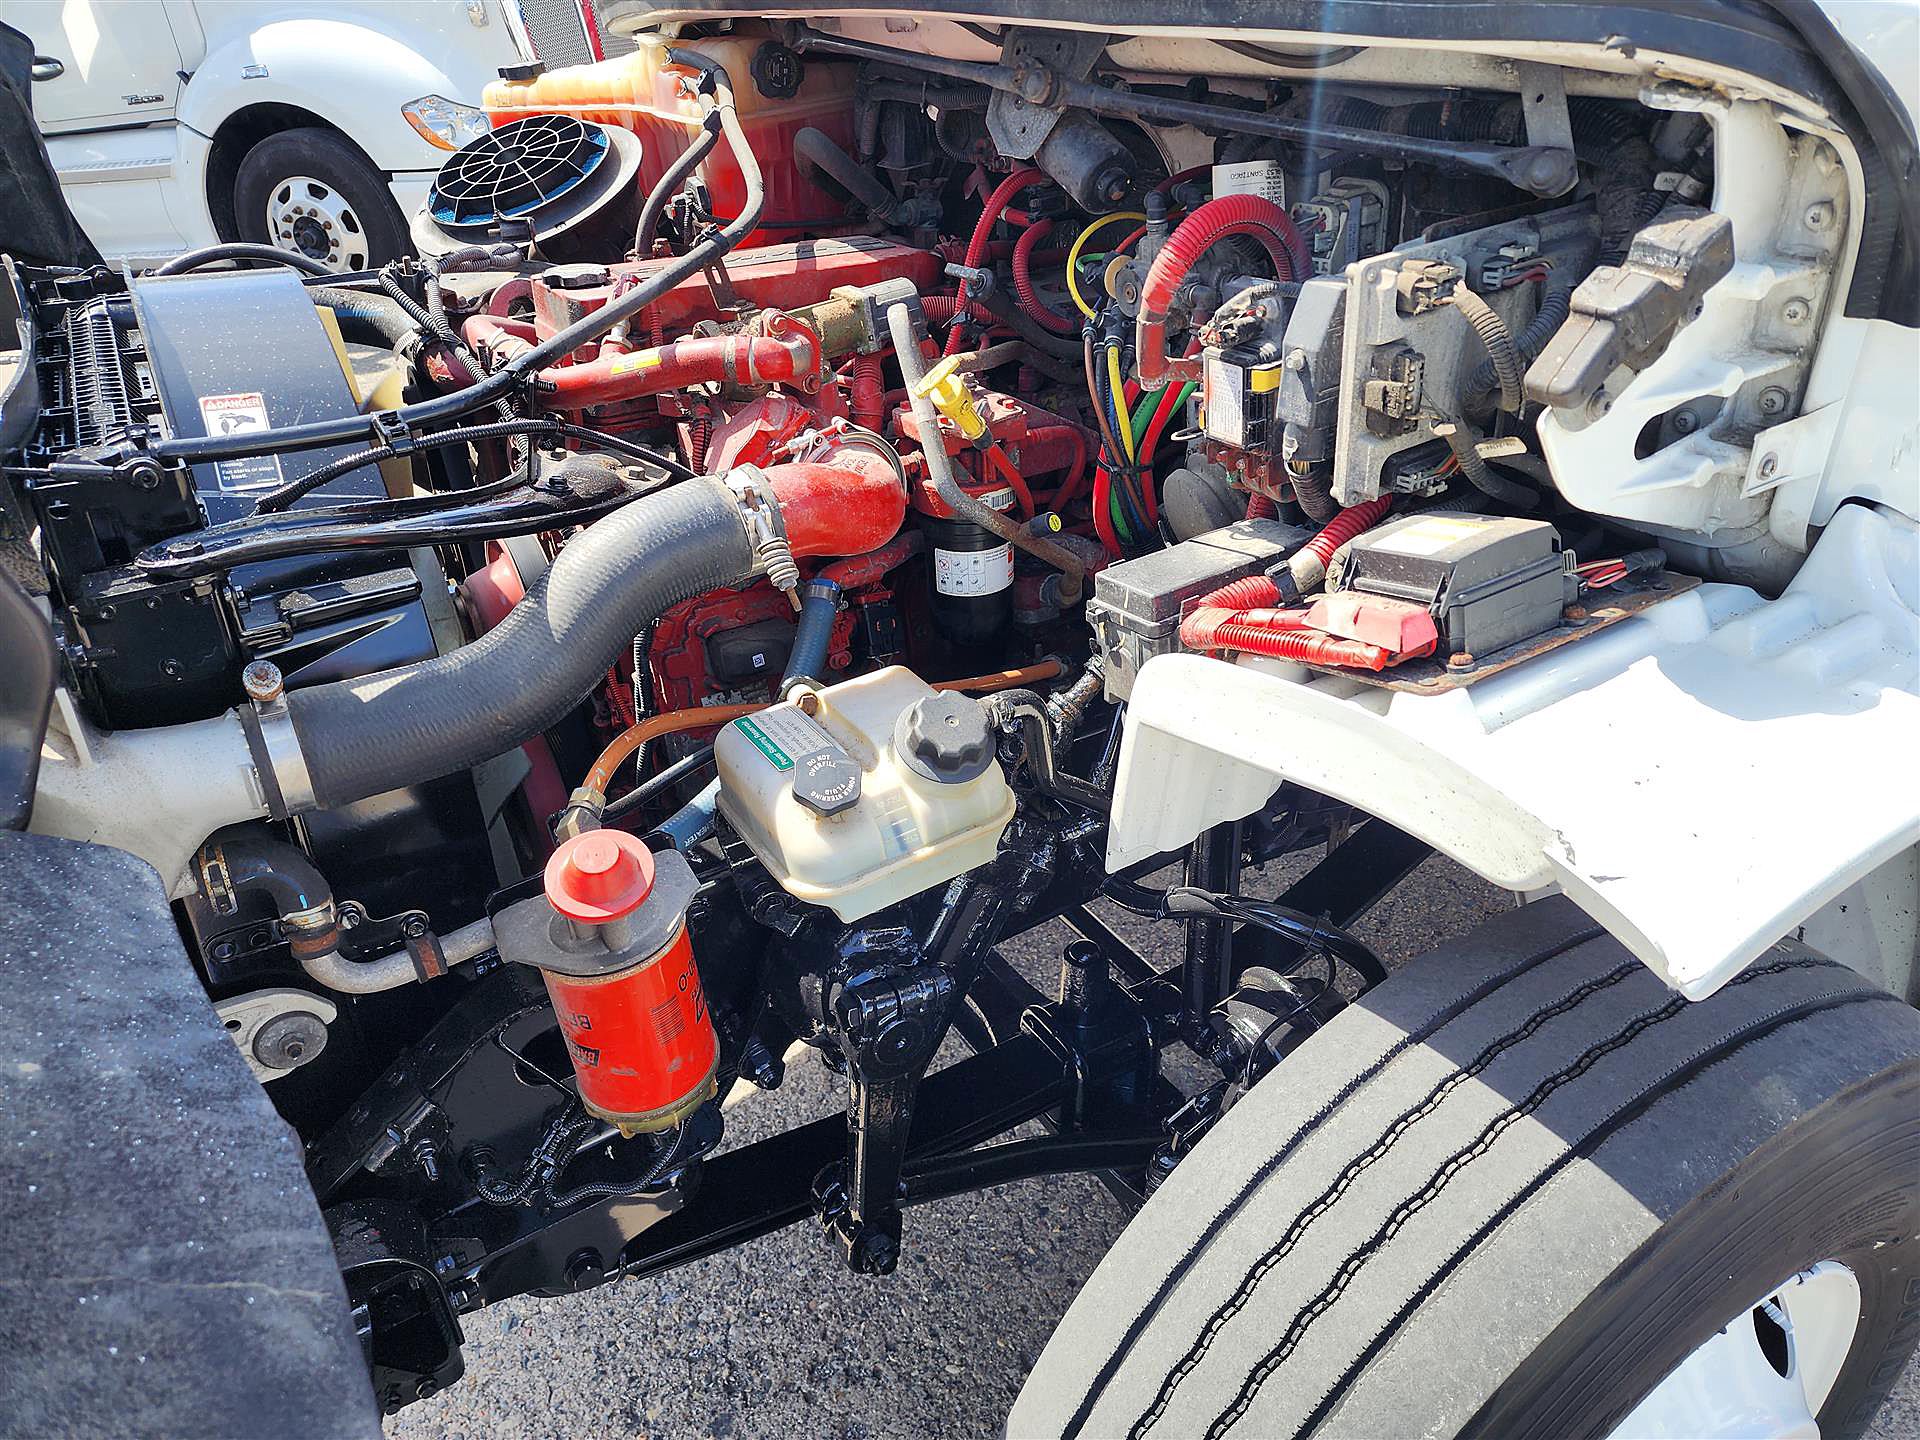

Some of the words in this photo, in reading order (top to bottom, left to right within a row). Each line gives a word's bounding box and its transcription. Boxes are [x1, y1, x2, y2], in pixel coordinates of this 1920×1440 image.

[216, 399, 261, 410] DANGER
[807, 759, 817, 767] DO
[817, 754, 831, 762] NOT
[808, 761, 837, 777] OVERFILL
[824, 783, 846, 795] FLUID
[841, 776, 856, 796] POWER
[810, 790, 844, 801] STEERING
